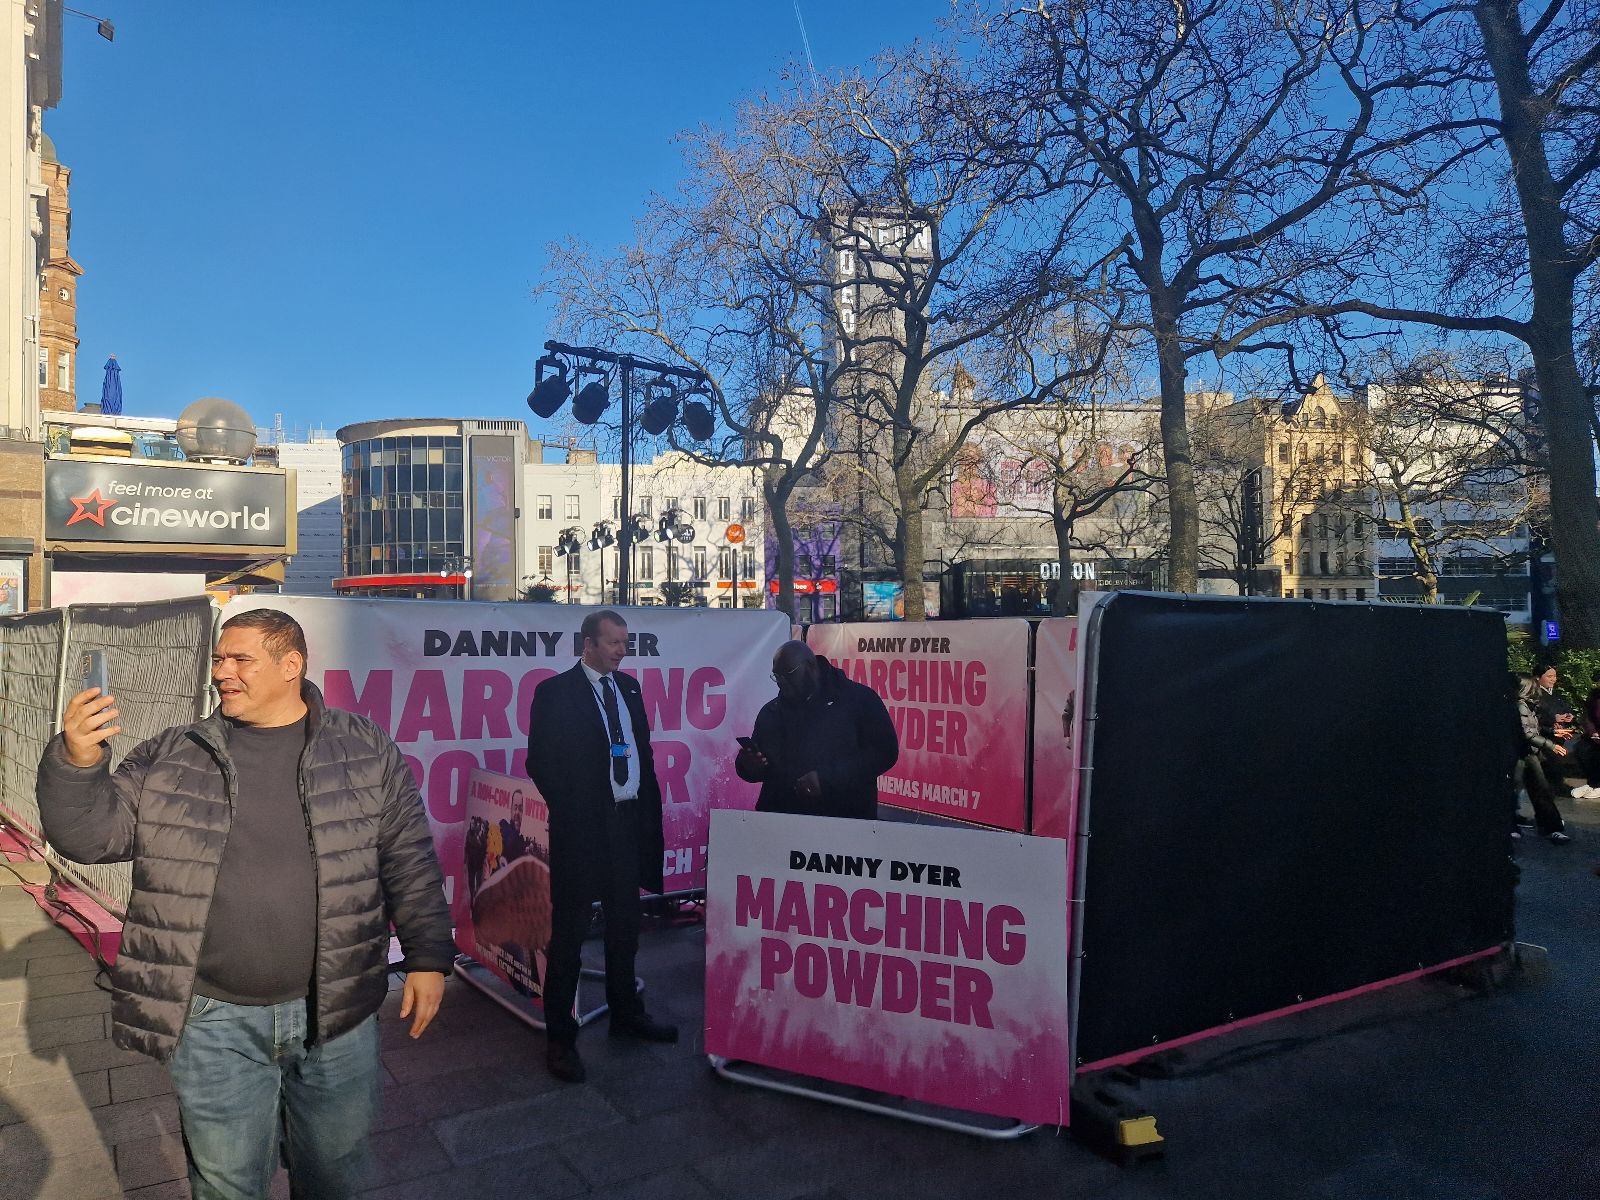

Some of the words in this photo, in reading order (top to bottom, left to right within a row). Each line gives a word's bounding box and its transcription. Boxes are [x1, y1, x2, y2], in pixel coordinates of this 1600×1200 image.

[108, 480, 142, 496] feel
[144, 485, 192, 499] more
[195, 486, 213, 500] at
[111, 503, 270, 531] cineworld
[1040, 562, 1095, 580] ODON
[423, 629, 564, 657] DANNY
[857, 637, 906, 653] DANNY
[909, 637, 951, 654] DYER
[323, 666, 727, 743] MARCNG
[889, 705, 968, 757] DER
[922, 782, 968, 809] MARCH
[971, 790, 981, 810] 7
[789, 850, 883, 879] DANNY
[889, 859, 962, 889] DYER
[735, 874, 1027, 966] MARCHING
[760, 936, 995, 1030] POWDER
